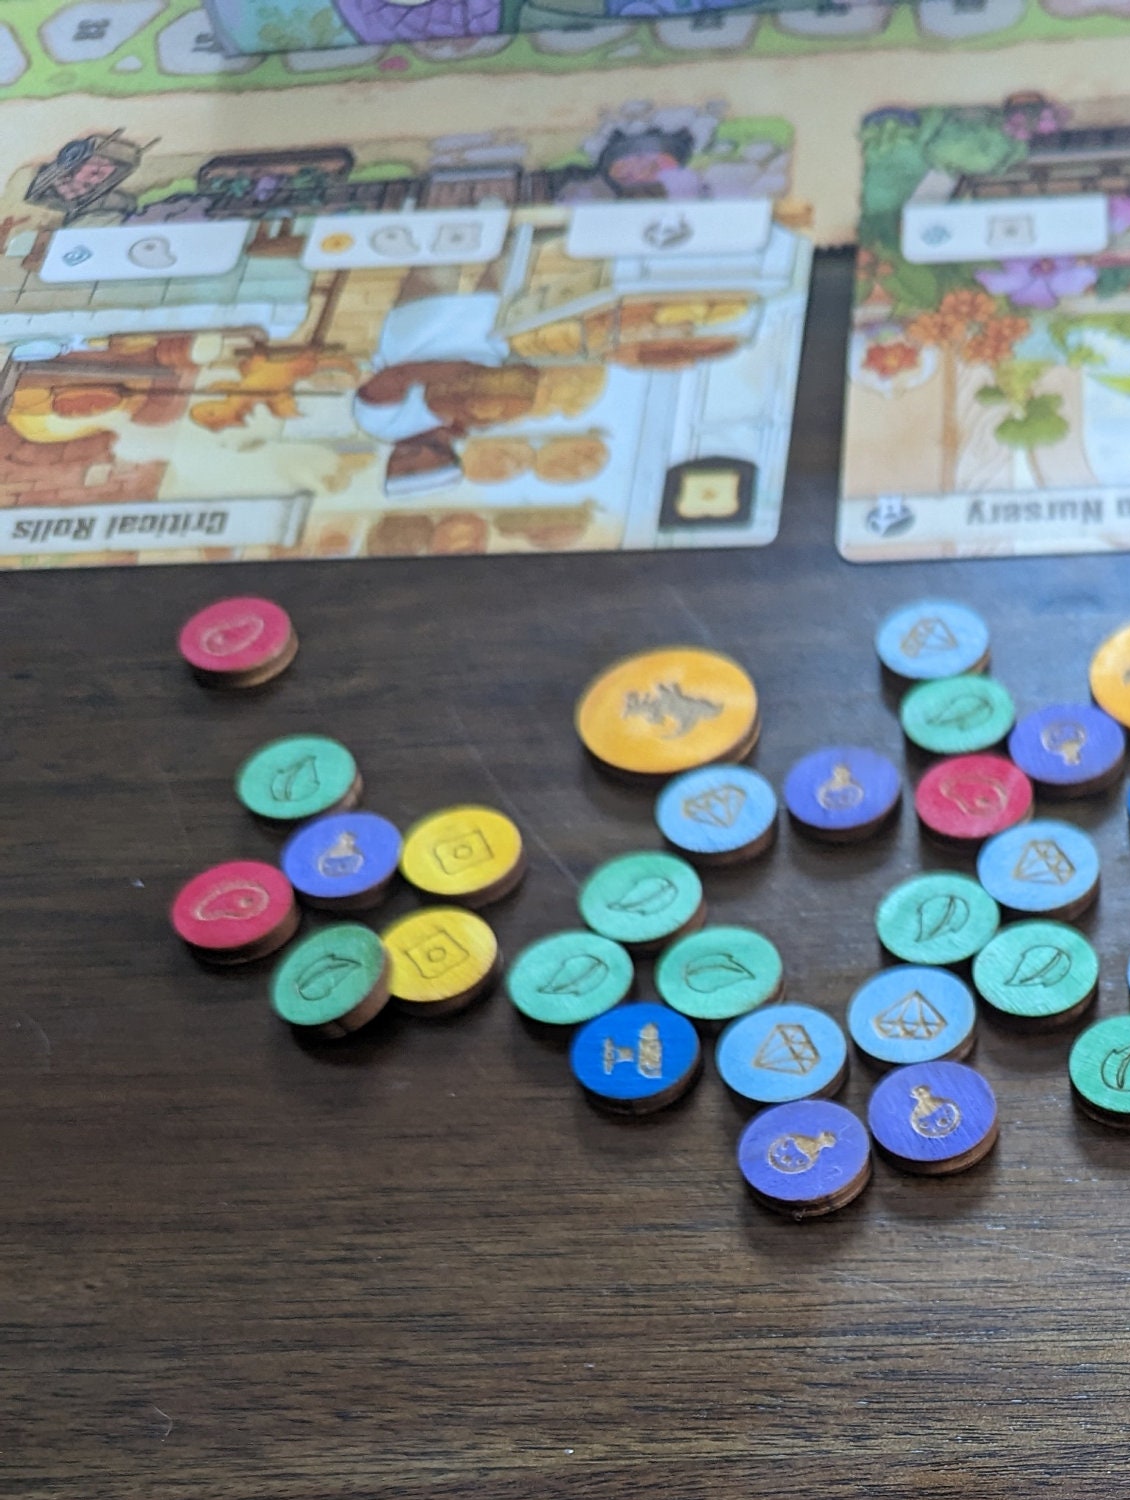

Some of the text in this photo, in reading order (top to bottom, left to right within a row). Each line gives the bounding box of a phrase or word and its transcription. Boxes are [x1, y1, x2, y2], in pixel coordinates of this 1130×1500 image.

[966, 499, 1104, 525] Nursery
[12, 511, 229, 543] Critical Rolls
